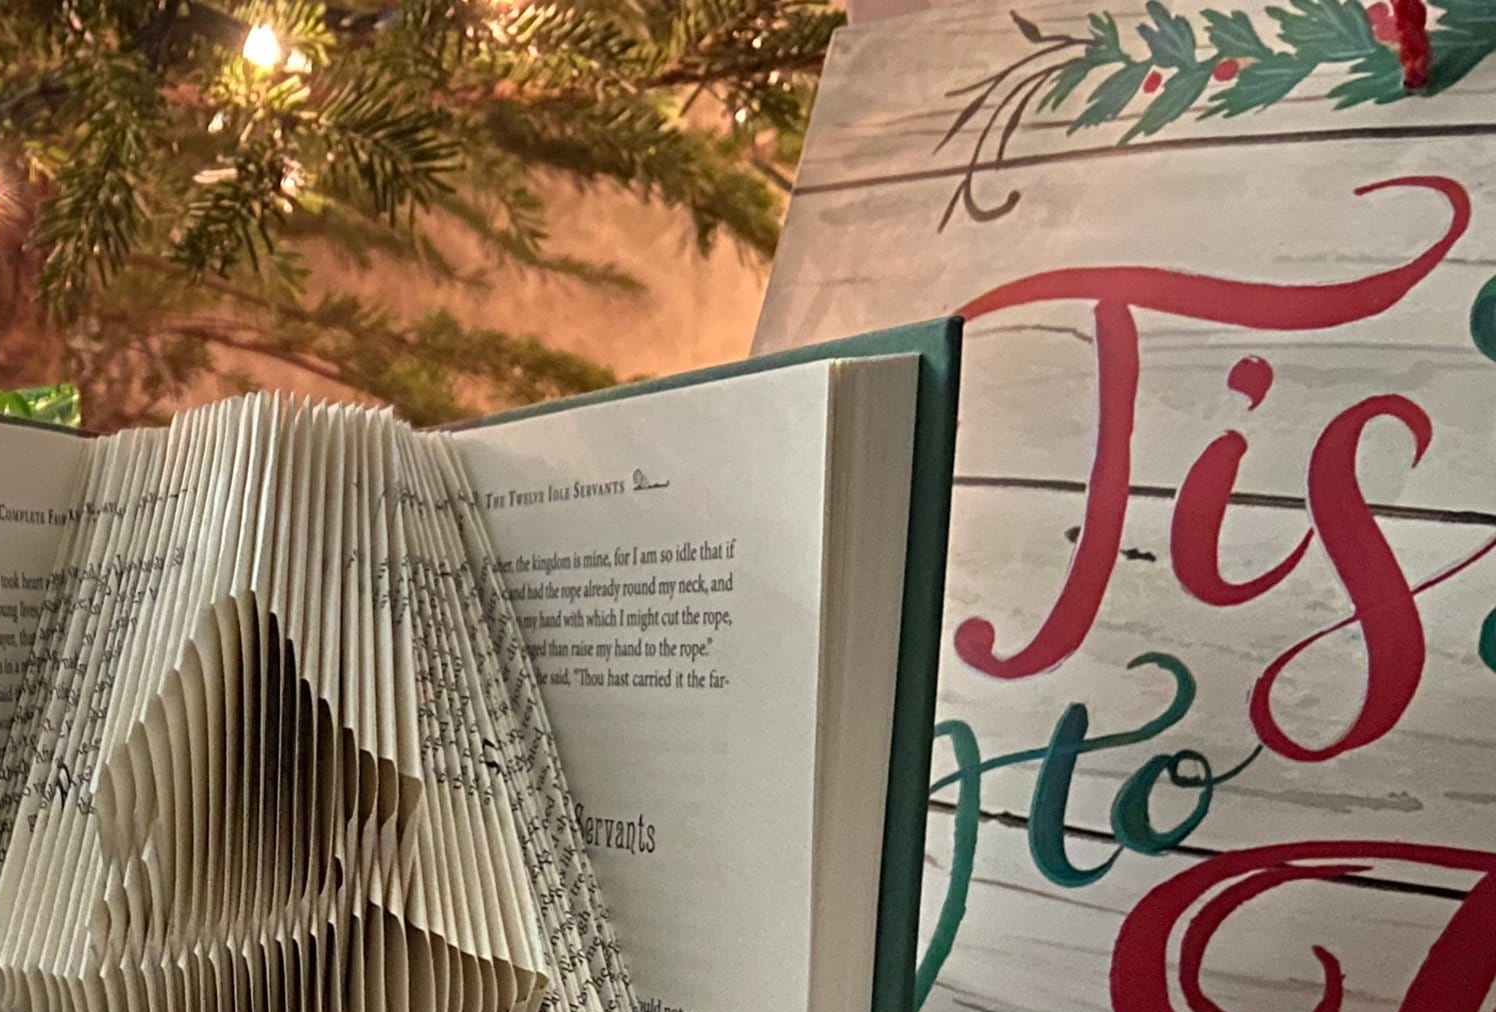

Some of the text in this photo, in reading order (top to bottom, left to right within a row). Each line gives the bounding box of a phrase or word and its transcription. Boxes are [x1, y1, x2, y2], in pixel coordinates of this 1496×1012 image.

[515, 554, 529, 573] the
[532, 552, 571, 575] kingdom
[573, 552, 581, 568] is
[583, 549, 612, 568] mine,
[614, 547, 631, 566] for
[640, 550, 657, 564] am
[660, 549, 673, 562] so
[676, 542, 697, 562] idle
[700, 540, 722, 561] that
[726, 538, 736, 559] if
[526, 582, 544, 600] had
[545, 581, 560, 600] the
[560, 585, 582, 605] rope
[583, 578, 621, 602] already
[622, 576, 656, 597] round
[658, 580, 676, 600] my
[678, 573, 709, 594] neck,
[710, 571, 733, 592] and
[539, 611, 562, 628] hand
[563, 610, 585, 628] with
[586, 608, 617, 628] which
[626, 608, 660, 631] might
[661, 610, 679, 626] cut
[681, 605, 701, 625] the
[702, 611, 733, 630] rope,
[548, 639, 569, 657] than
[570, 642, 594, 657] raise
[595, 644, 613, 662] my
[614, 637, 642, 657] hand
[644, 642, 657, 657] to
[658, 637, 677, 656] the
[607, 668, 630, 688] hast
[631, 668, 672, 688] carried
[675, 672, 684, 688] it
[686, 668, 706, 689] the
[573, 802, 656, 855] Servants
